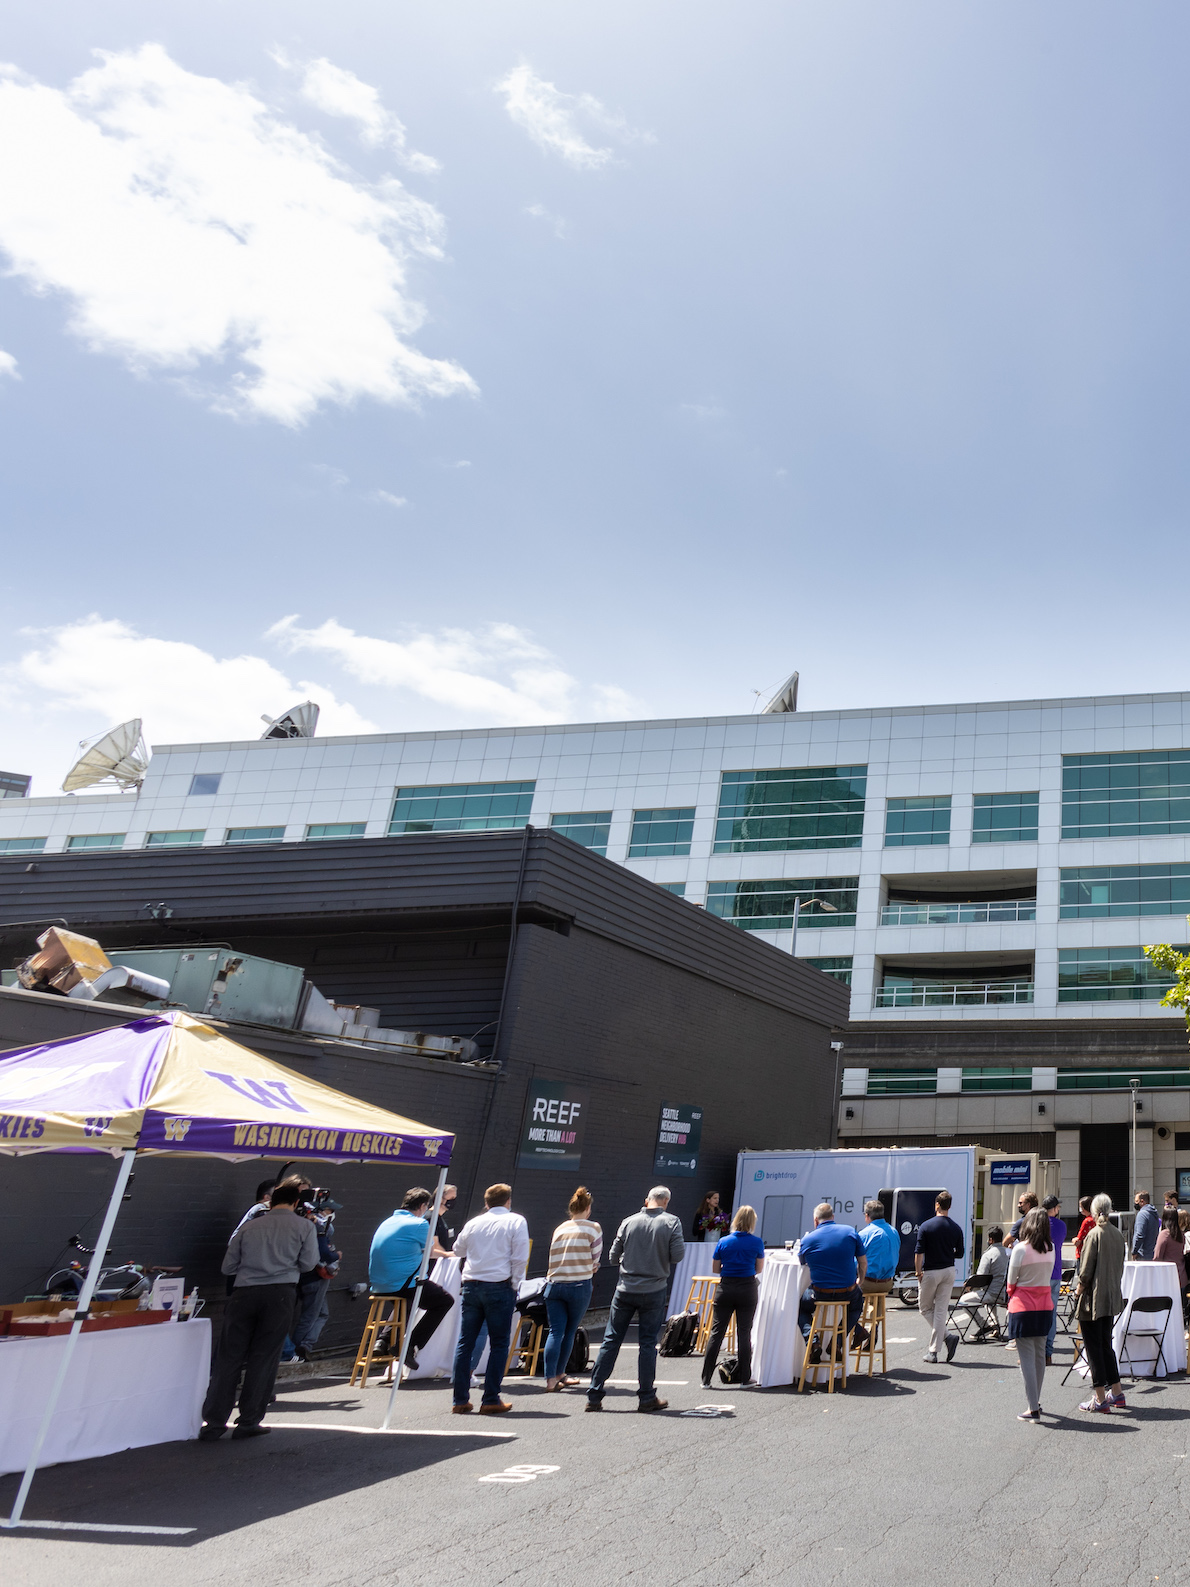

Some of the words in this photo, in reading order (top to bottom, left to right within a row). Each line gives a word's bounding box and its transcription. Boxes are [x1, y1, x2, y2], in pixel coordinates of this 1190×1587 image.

[200, 1067, 313, 1115] W
[532, 1097, 581, 1125] REEF
[662, 1108, 680, 1120] SEATTLE
[83, 1117, 114, 1138] W
[164, 1118, 192, 1141] W
[528, 1127, 547, 1142] MORE
[546, 1129, 561, 1143] THAN
[560, 1131, 565, 1143] A
[565, 1132, 576, 1144] LOT
[233, 1125, 340, 1151] WASHINGTON
[341, 1132, 404, 1156] HUSKIES
[659, 1131, 679, 1144] DELIVERY
[423, 1139, 443, 1157] W
[765, 1171, 797, 1180] brightdrop
[992, 1165, 1014, 1174] mobile
[821, 1196, 854, 1213] The
[478, 1464, 561, 1483] 09
